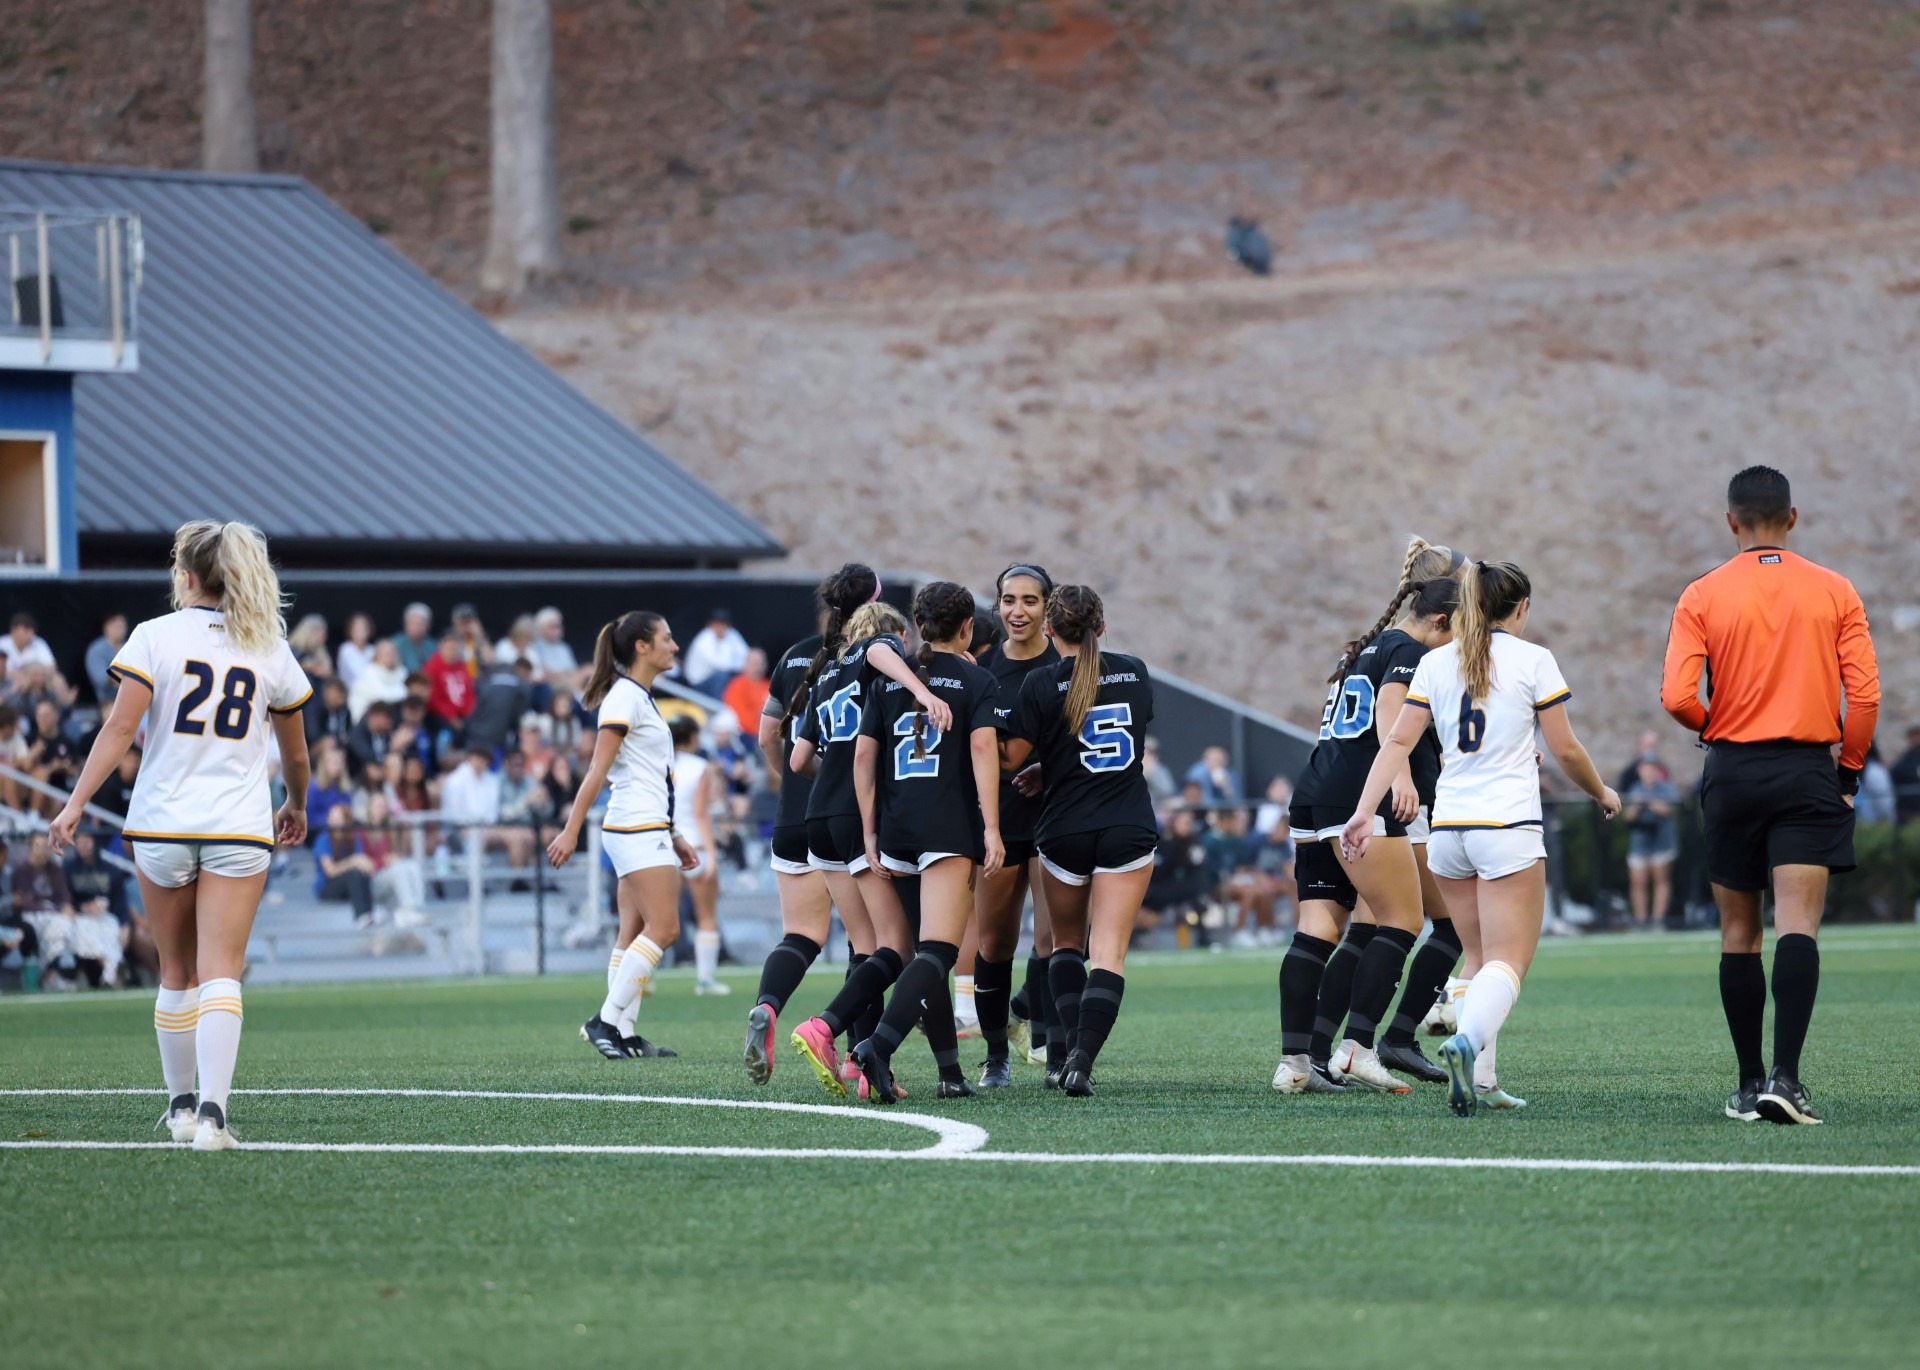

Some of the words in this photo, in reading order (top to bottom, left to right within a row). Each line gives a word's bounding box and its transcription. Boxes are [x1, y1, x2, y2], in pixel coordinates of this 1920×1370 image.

[173, 658, 257, 742] 28
[1457, 684, 1486, 755] 6
[893, 711, 942, 781] 2
[1078, 702, 1136, 774] 5
